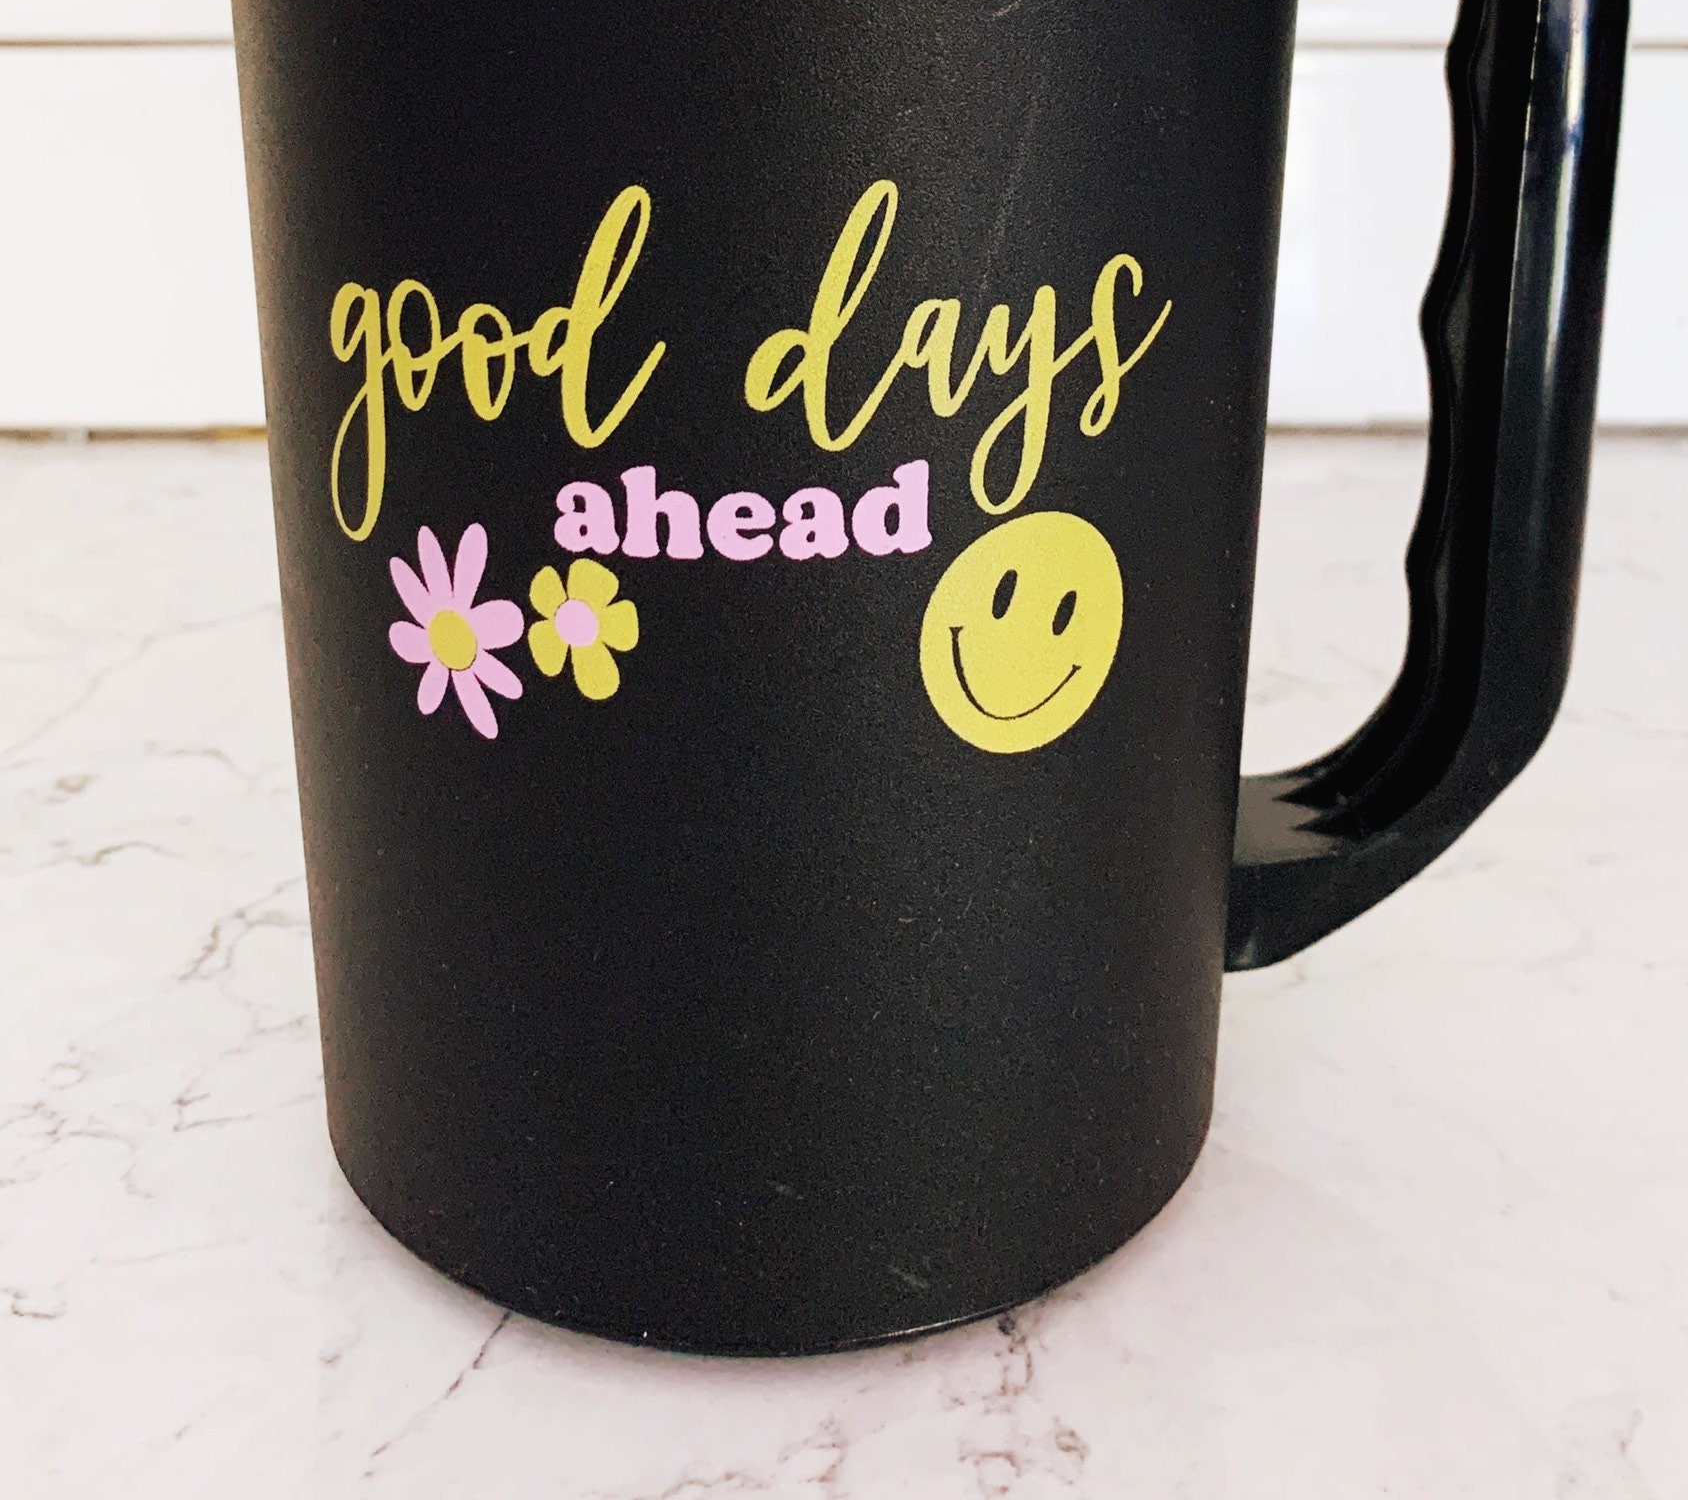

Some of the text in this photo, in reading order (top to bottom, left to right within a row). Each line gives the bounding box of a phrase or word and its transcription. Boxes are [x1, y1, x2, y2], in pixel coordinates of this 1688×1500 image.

[330, 179, 1173, 542] good days
[553, 459, 933, 562] ahead
